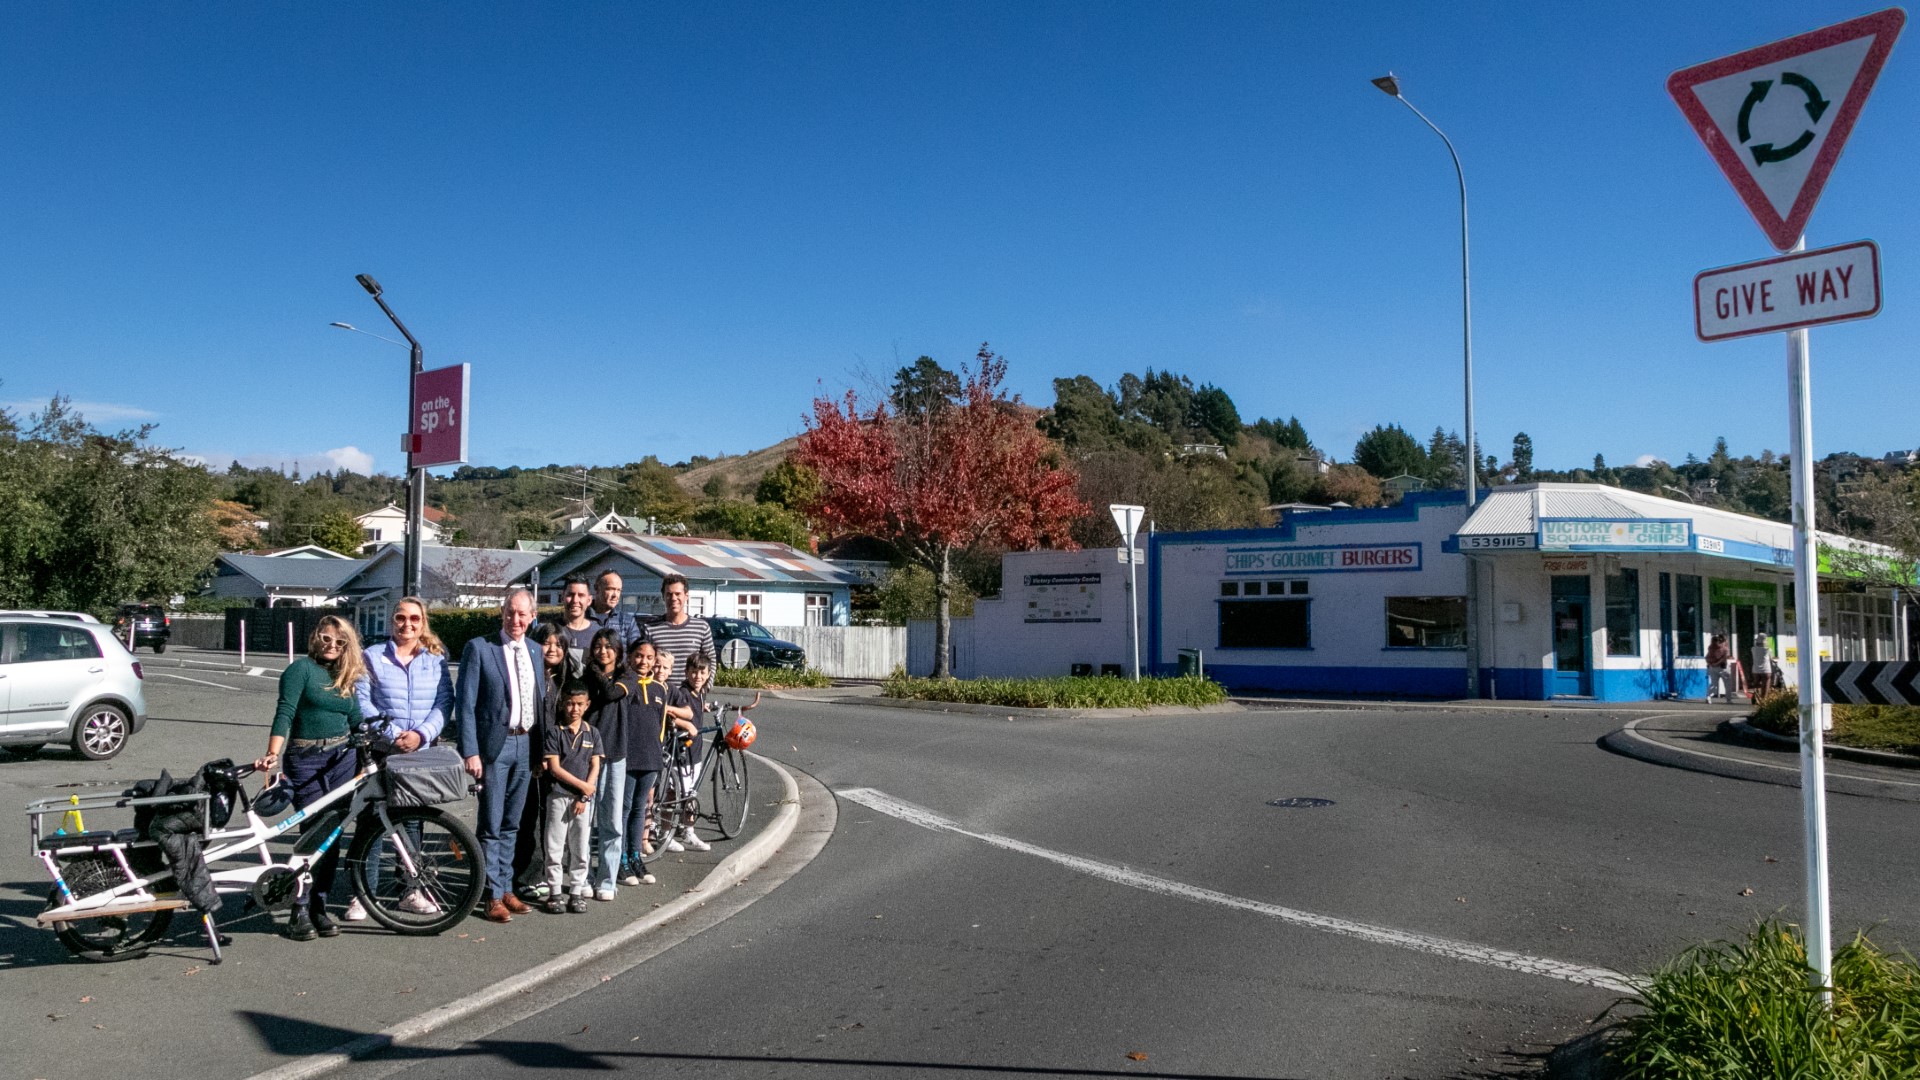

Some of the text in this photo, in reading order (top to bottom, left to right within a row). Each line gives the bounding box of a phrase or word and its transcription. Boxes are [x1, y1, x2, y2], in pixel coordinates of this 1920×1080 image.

[1715, 264, 1854, 320] GIVE WAY
[421, 396, 450, 411] on the
[420, 405, 456, 434] spt
[1544, 522, 1684, 534] VICTORY FISH
[1471, 536, 1526, 548] 5391115
[1546, 533, 1612, 544] SQUARE
[1635, 533, 1685, 544] CHIPS
[1226, 548, 1413, 569] CHIPS GOURMET BURGERS
[1051, 576, 1080, 584] Community
